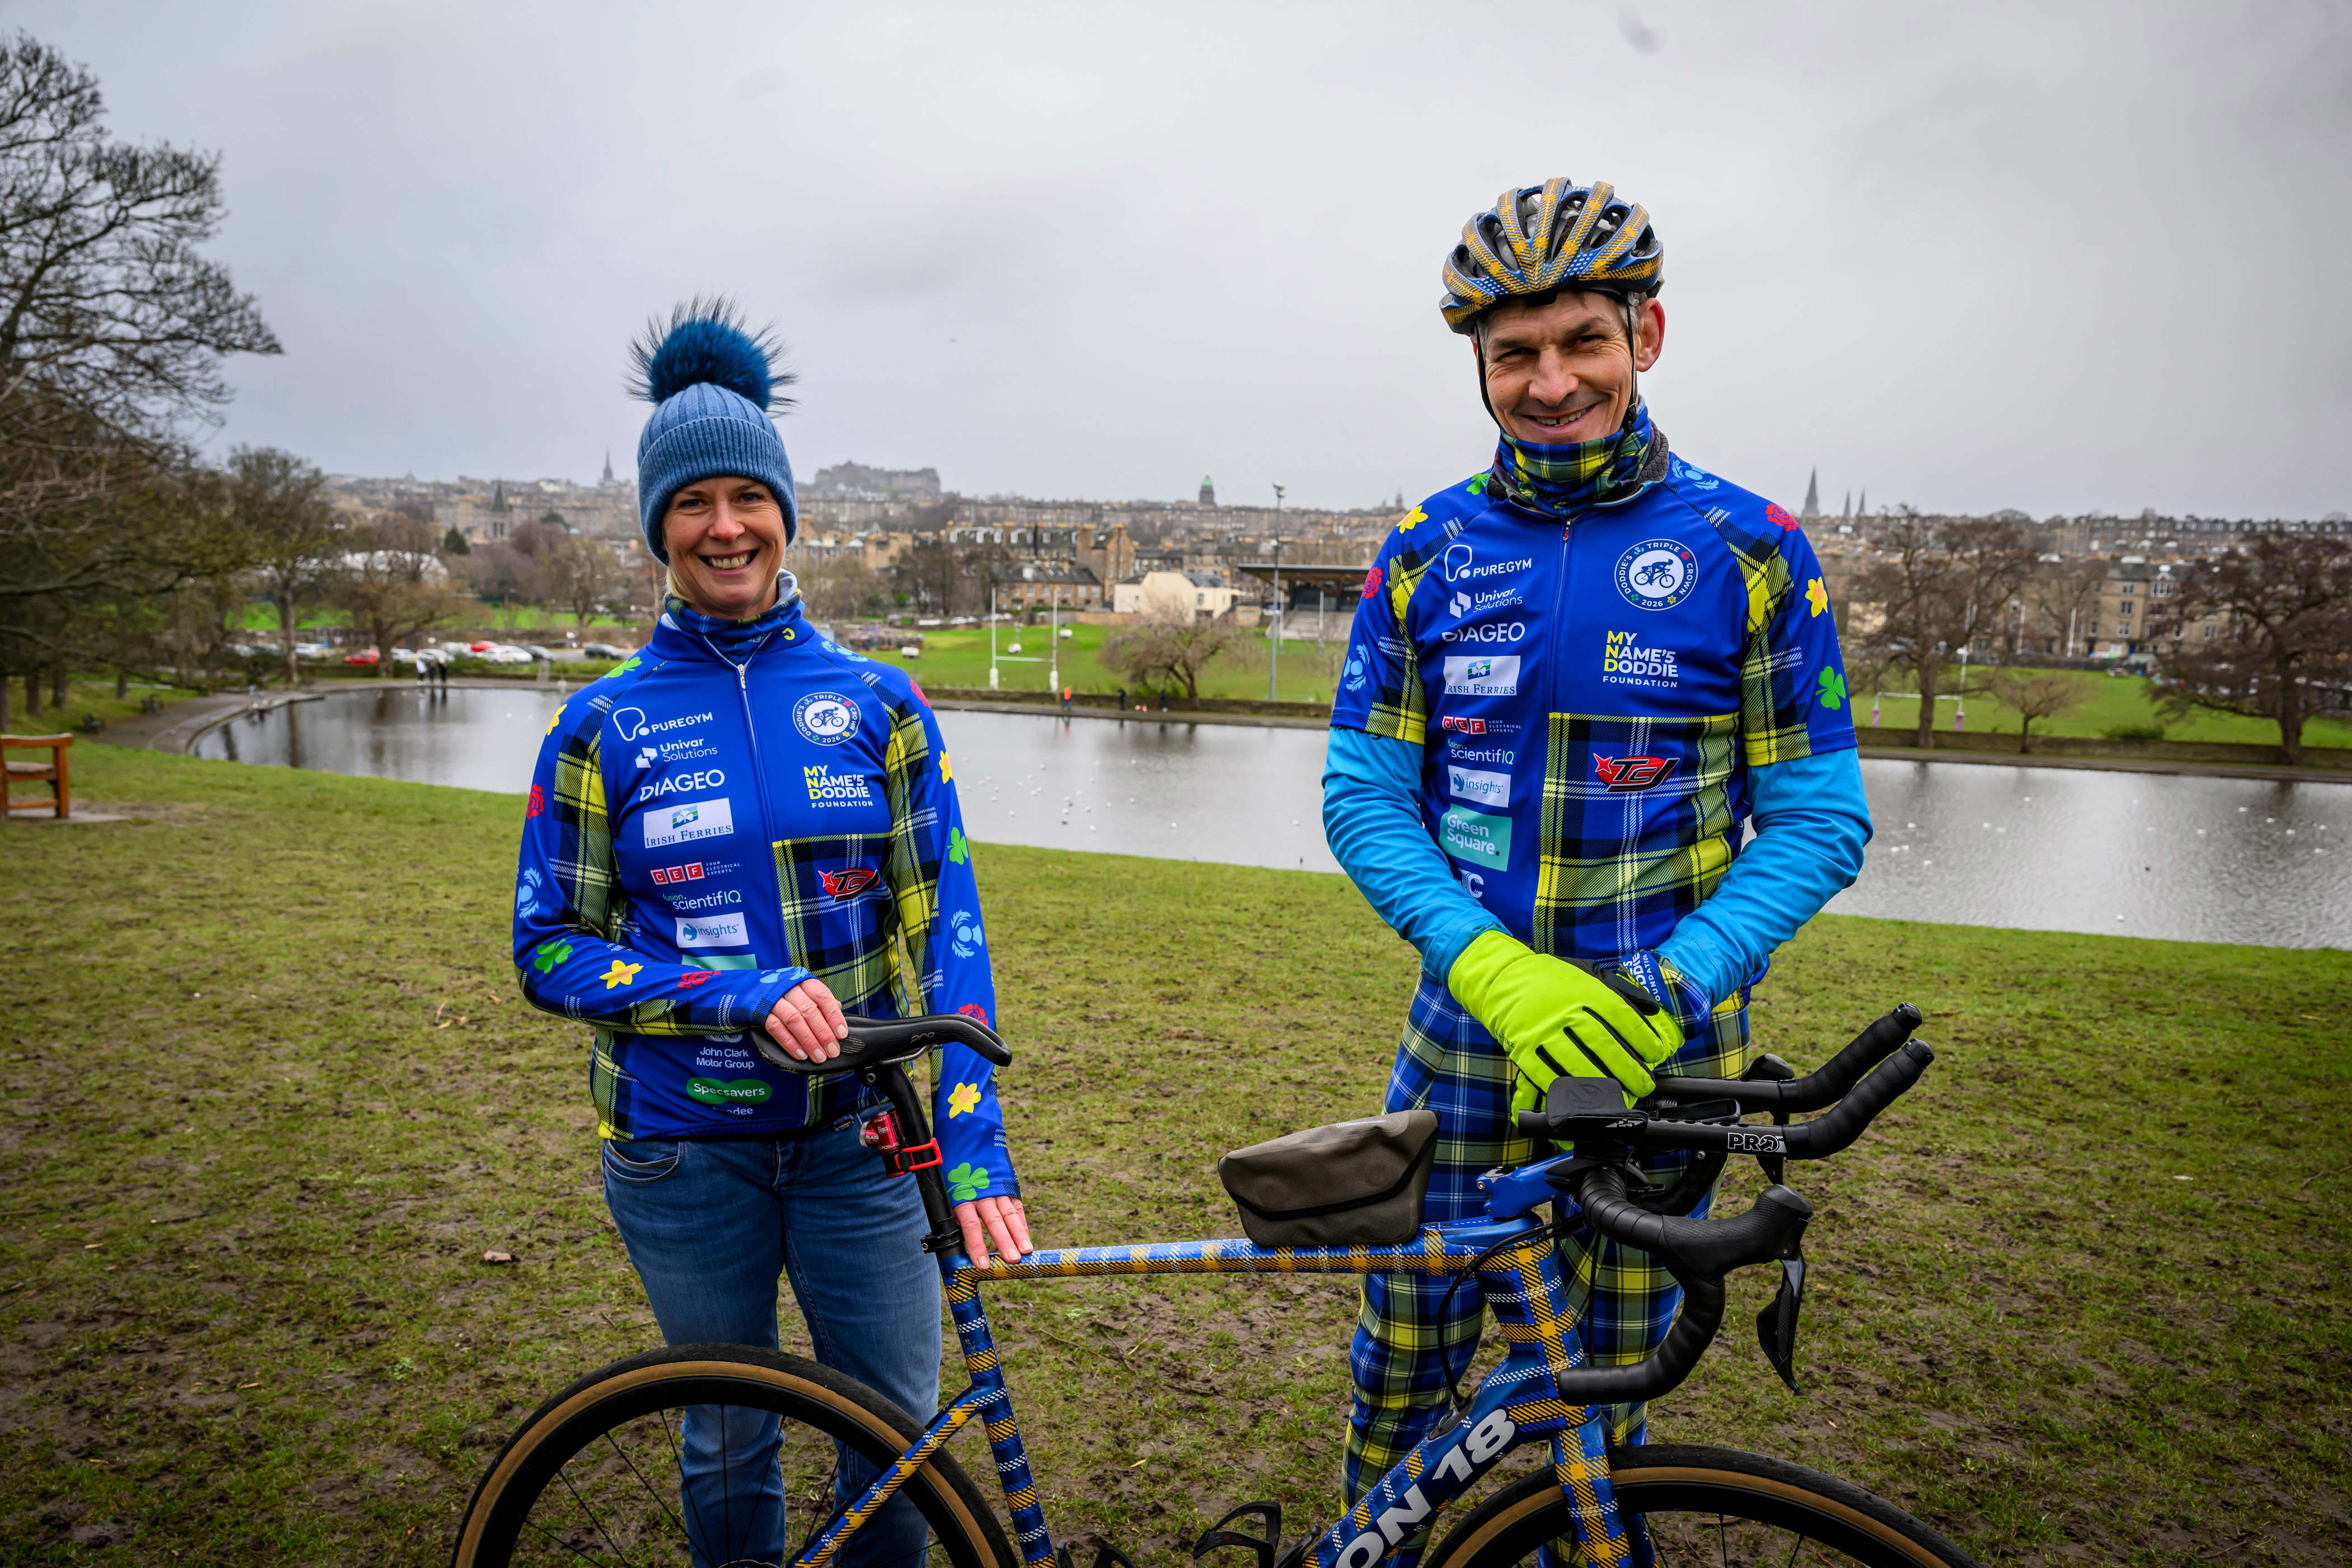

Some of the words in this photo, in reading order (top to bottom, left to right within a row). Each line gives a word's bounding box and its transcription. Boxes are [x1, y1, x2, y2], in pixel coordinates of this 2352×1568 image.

[1473, 558, 1532, 578] PUREGYM
[1619, 555, 1633, 594] DODDIE'S
[1646, 542, 1680, 552] TRIPLE
[1679, 563, 1693, 595] CROWN
[1475, 588, 1516, 604] Univar
[1472, 596, 1523, 613] Solutions
[1442, 622, 1526, 643] DIAGEO
[1607, 630, 1638, 646] MY
[1604, 659, 1678, 678] DODDIE
[1446, 682, 1469, 693] IRISH
[1473, 684, 1515, 695] FERRIES
[1603, 676, 1678, 688] FOUNDATION
[650, 712, 714, 734] PUREGYM
[796, 705, 812, 736] DODDIE'S
[849, 707, 858, 731] CROWN
[660, 739, 705, 752] Univar
[1447, 738, 1464, 749] fusion
[663, 747, 718, 762] Solutions
[804, 765, 828, 777] MY
[640, 769, 725, 802] DIAGEO
[809, 787, 871, 800] DODDIE
[1466, 778, 1501, 794] insights
[811, 800, 873, 809] FOUNDATION
[1447, 814, 1489, 838] Green
[646, 835, 676, 847] IRISH
[680, 825, 732, 840] FERRIES
[706, 863, 740, 871] ELECTRICAL
[696, 924, 738, 938] insights
[700, 1047, 722, 1057] John
[724, 1049, 749, 1057] Clark
[697, 1057, 723, 1068] Motor
[725, 1060, 754, 1070] Group
[694, 1083, 766, 1097] Specsavers
[1727, 1132, 1779, 1152] PRO
[1433, 1409, 1515, 1482] 18
